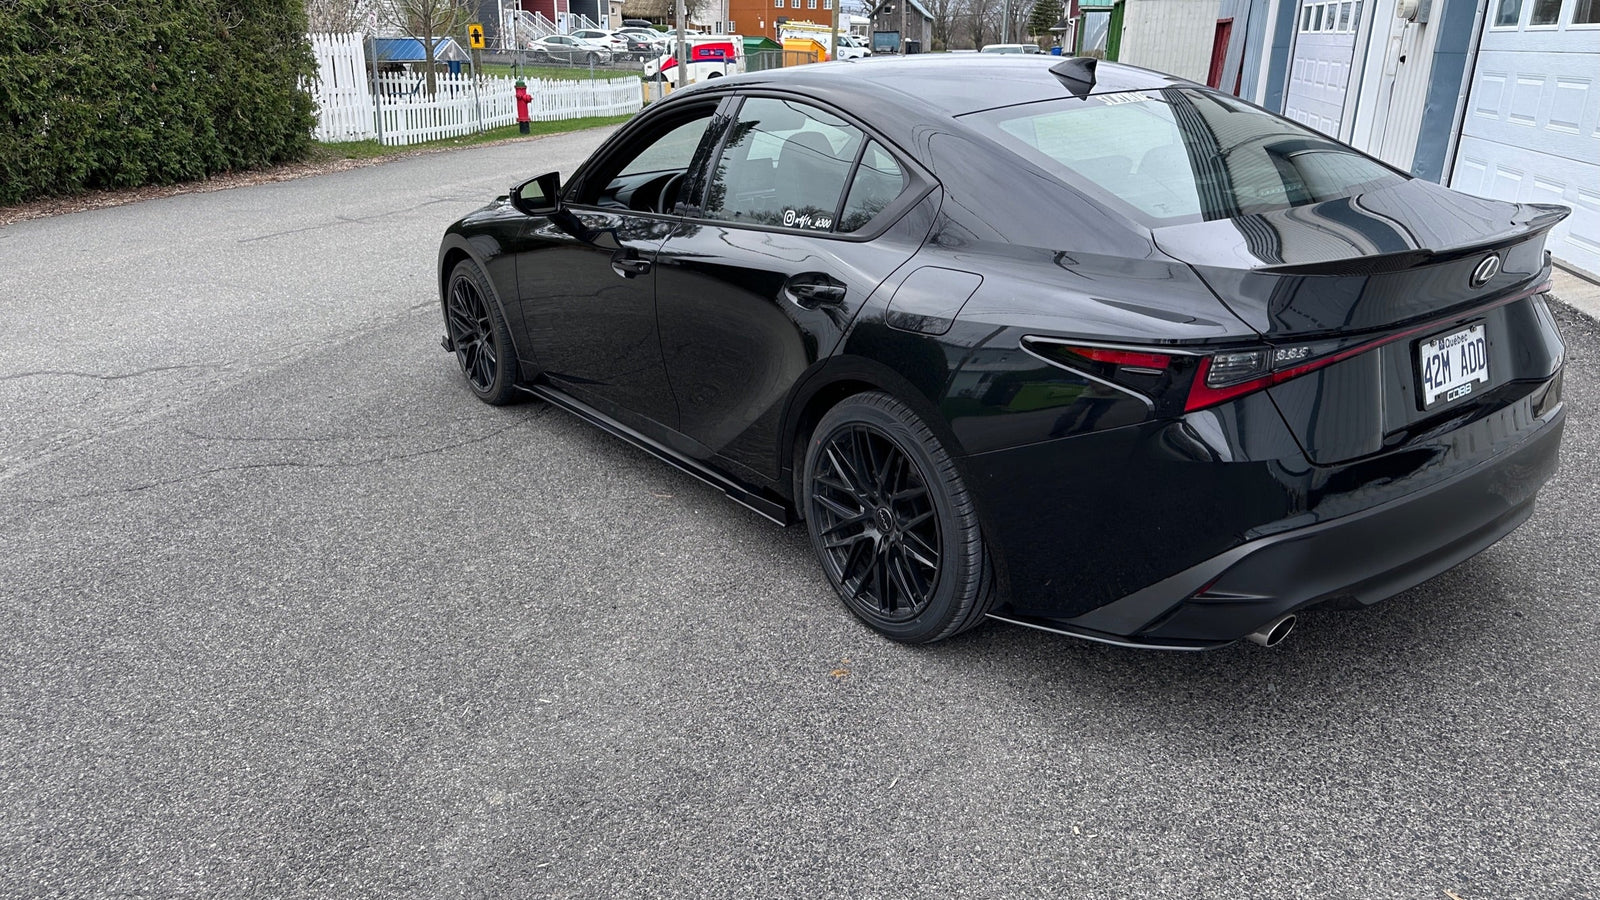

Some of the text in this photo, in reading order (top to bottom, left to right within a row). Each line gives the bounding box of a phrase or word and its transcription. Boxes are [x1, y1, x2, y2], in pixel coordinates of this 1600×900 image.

[1445, 333, 1468, 349] Québec
[1424, 337, 1487, 391] 42M ADD
